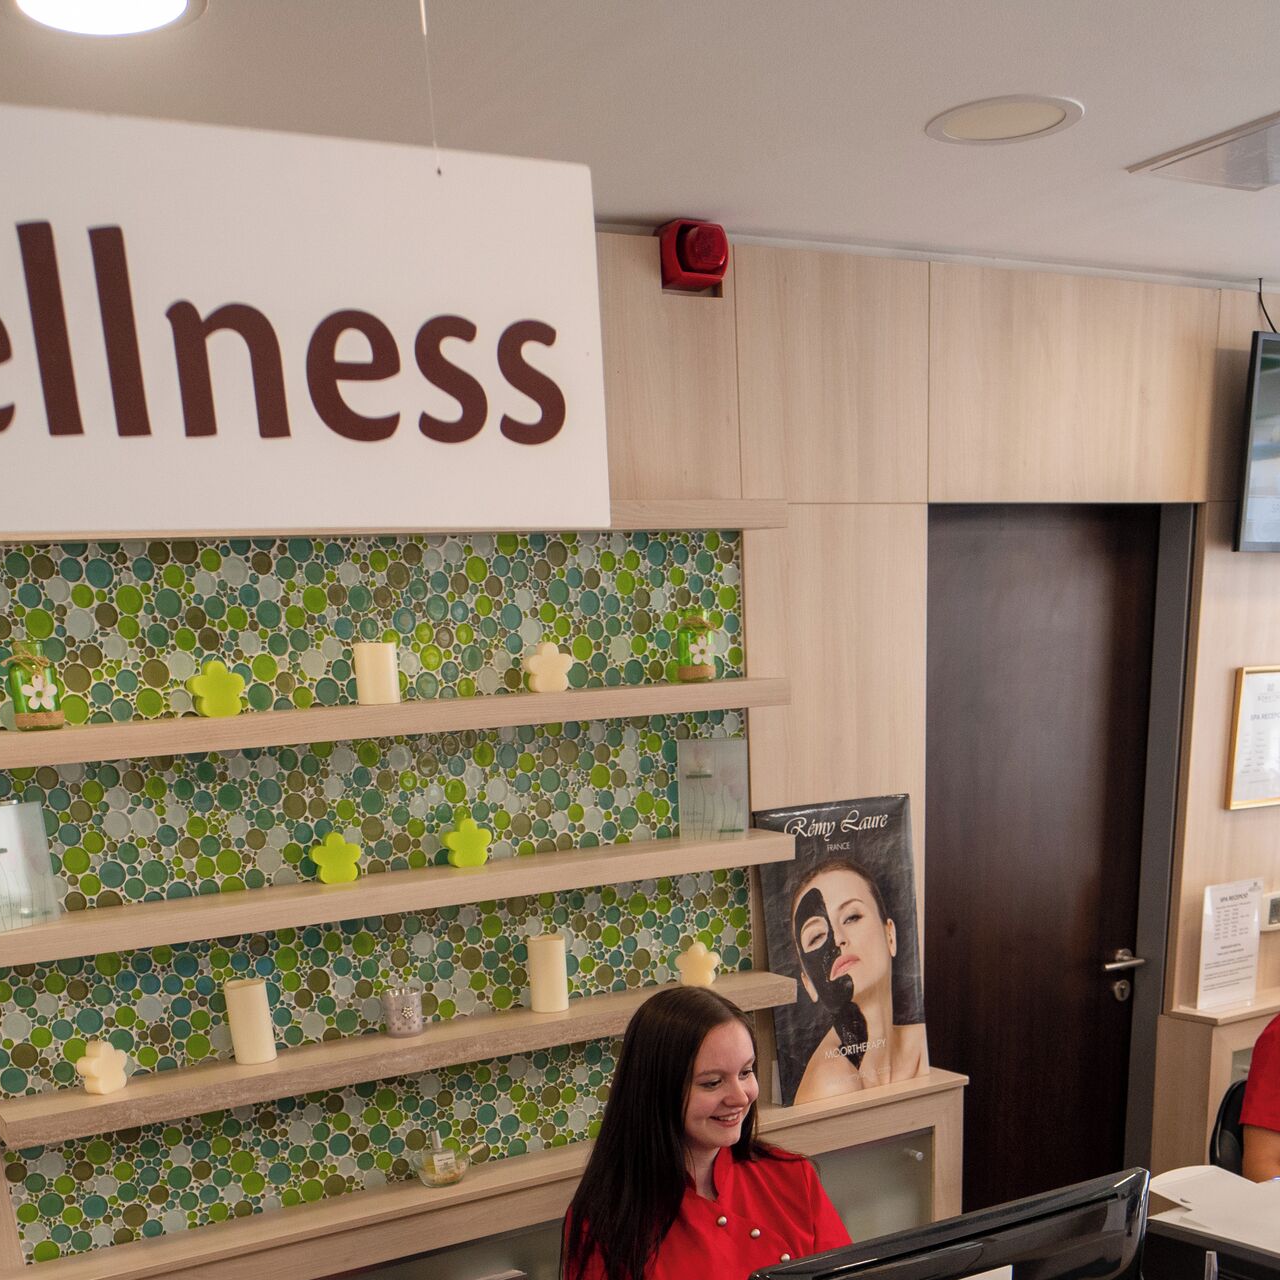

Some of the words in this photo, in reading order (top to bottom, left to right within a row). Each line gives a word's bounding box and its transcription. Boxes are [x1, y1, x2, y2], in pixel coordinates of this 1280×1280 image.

[784, 816, 836, 841] Rémy
[840, 809, 888, 833] Laure
[826, 841, 850, 852] FRANCE
[824, 1038, 887, 1060] MOORTHERAPY
